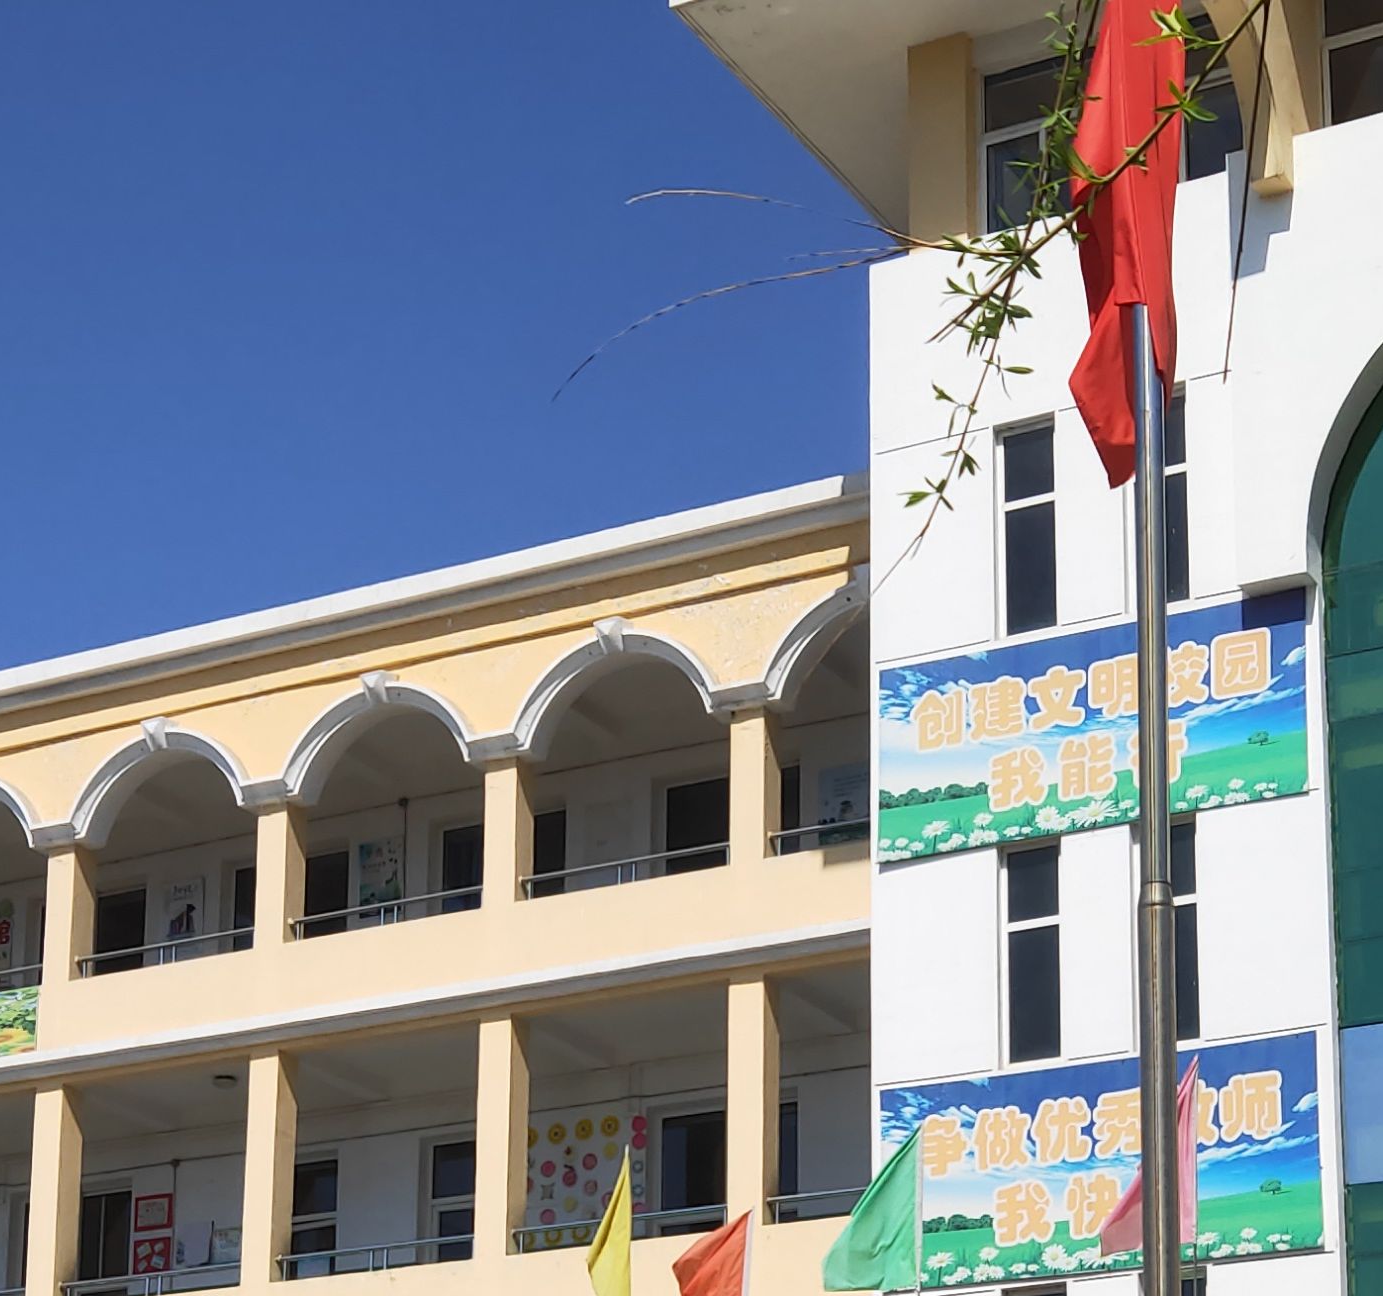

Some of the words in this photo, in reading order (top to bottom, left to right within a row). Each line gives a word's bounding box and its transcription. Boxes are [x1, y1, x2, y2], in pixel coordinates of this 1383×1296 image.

[910, 627, 1271, 752] 创建文明校园
